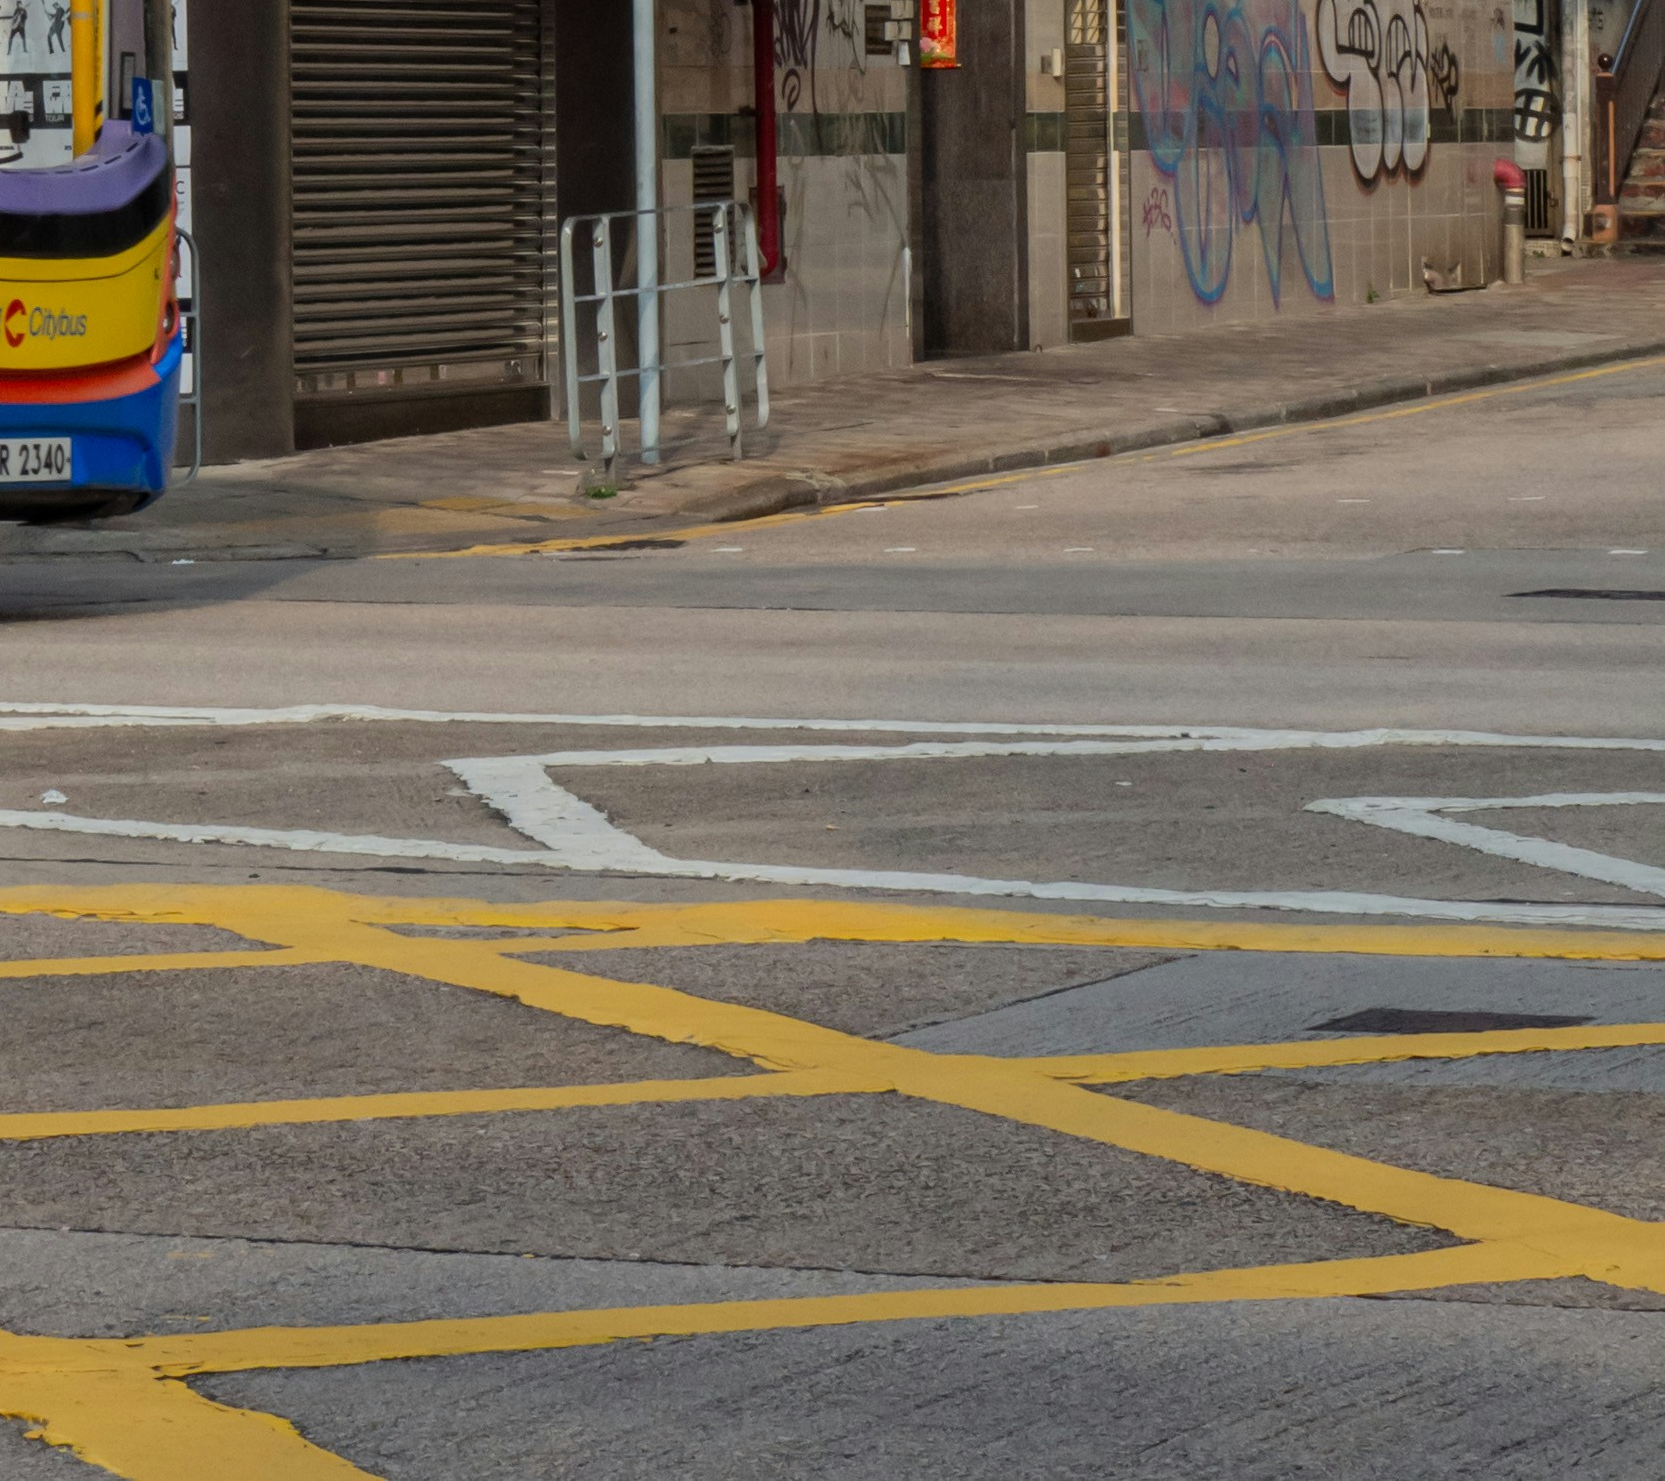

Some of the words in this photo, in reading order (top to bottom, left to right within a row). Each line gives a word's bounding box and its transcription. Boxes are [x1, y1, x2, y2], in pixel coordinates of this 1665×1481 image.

[45, 113, 65, 123] TOUR
[29, 306, 88, 341] Citybus
[18, 443, 66, 476] 2340
